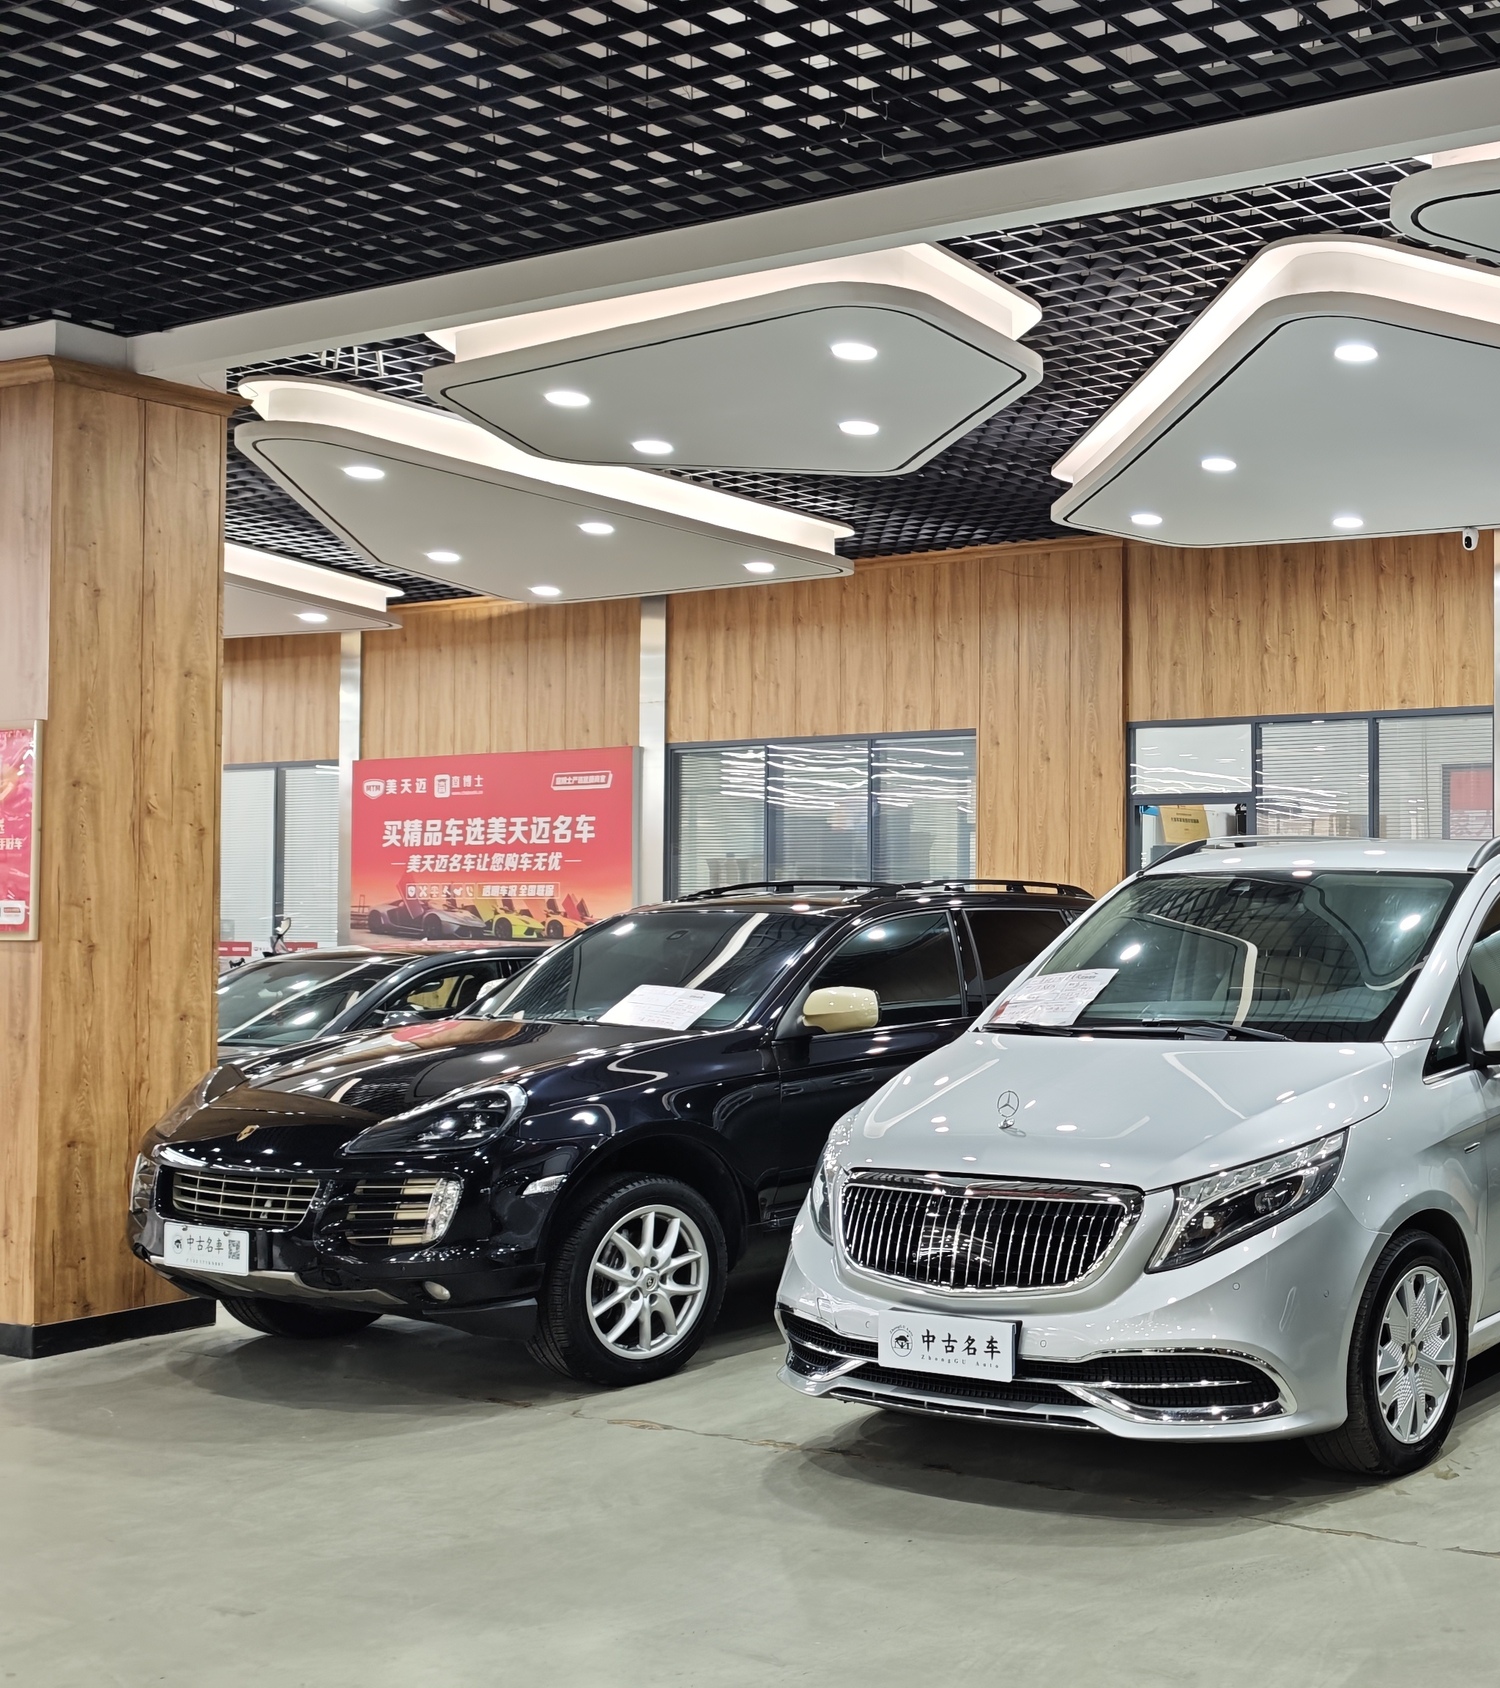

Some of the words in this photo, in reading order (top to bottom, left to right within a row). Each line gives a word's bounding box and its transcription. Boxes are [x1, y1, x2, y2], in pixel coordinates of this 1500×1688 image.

[385, 778, 427, 795] 美天迈
[382, 814, 596, 847] 买精品车选美天迈名车
[406, 851, 563, 873] 美天迈名车让您购车无忧
[921, 1329, 1001, 1360] 中古名车
[921, 1355, 966, 1364] ZhongGU
[976, 1361, 999, 1369] Auto
